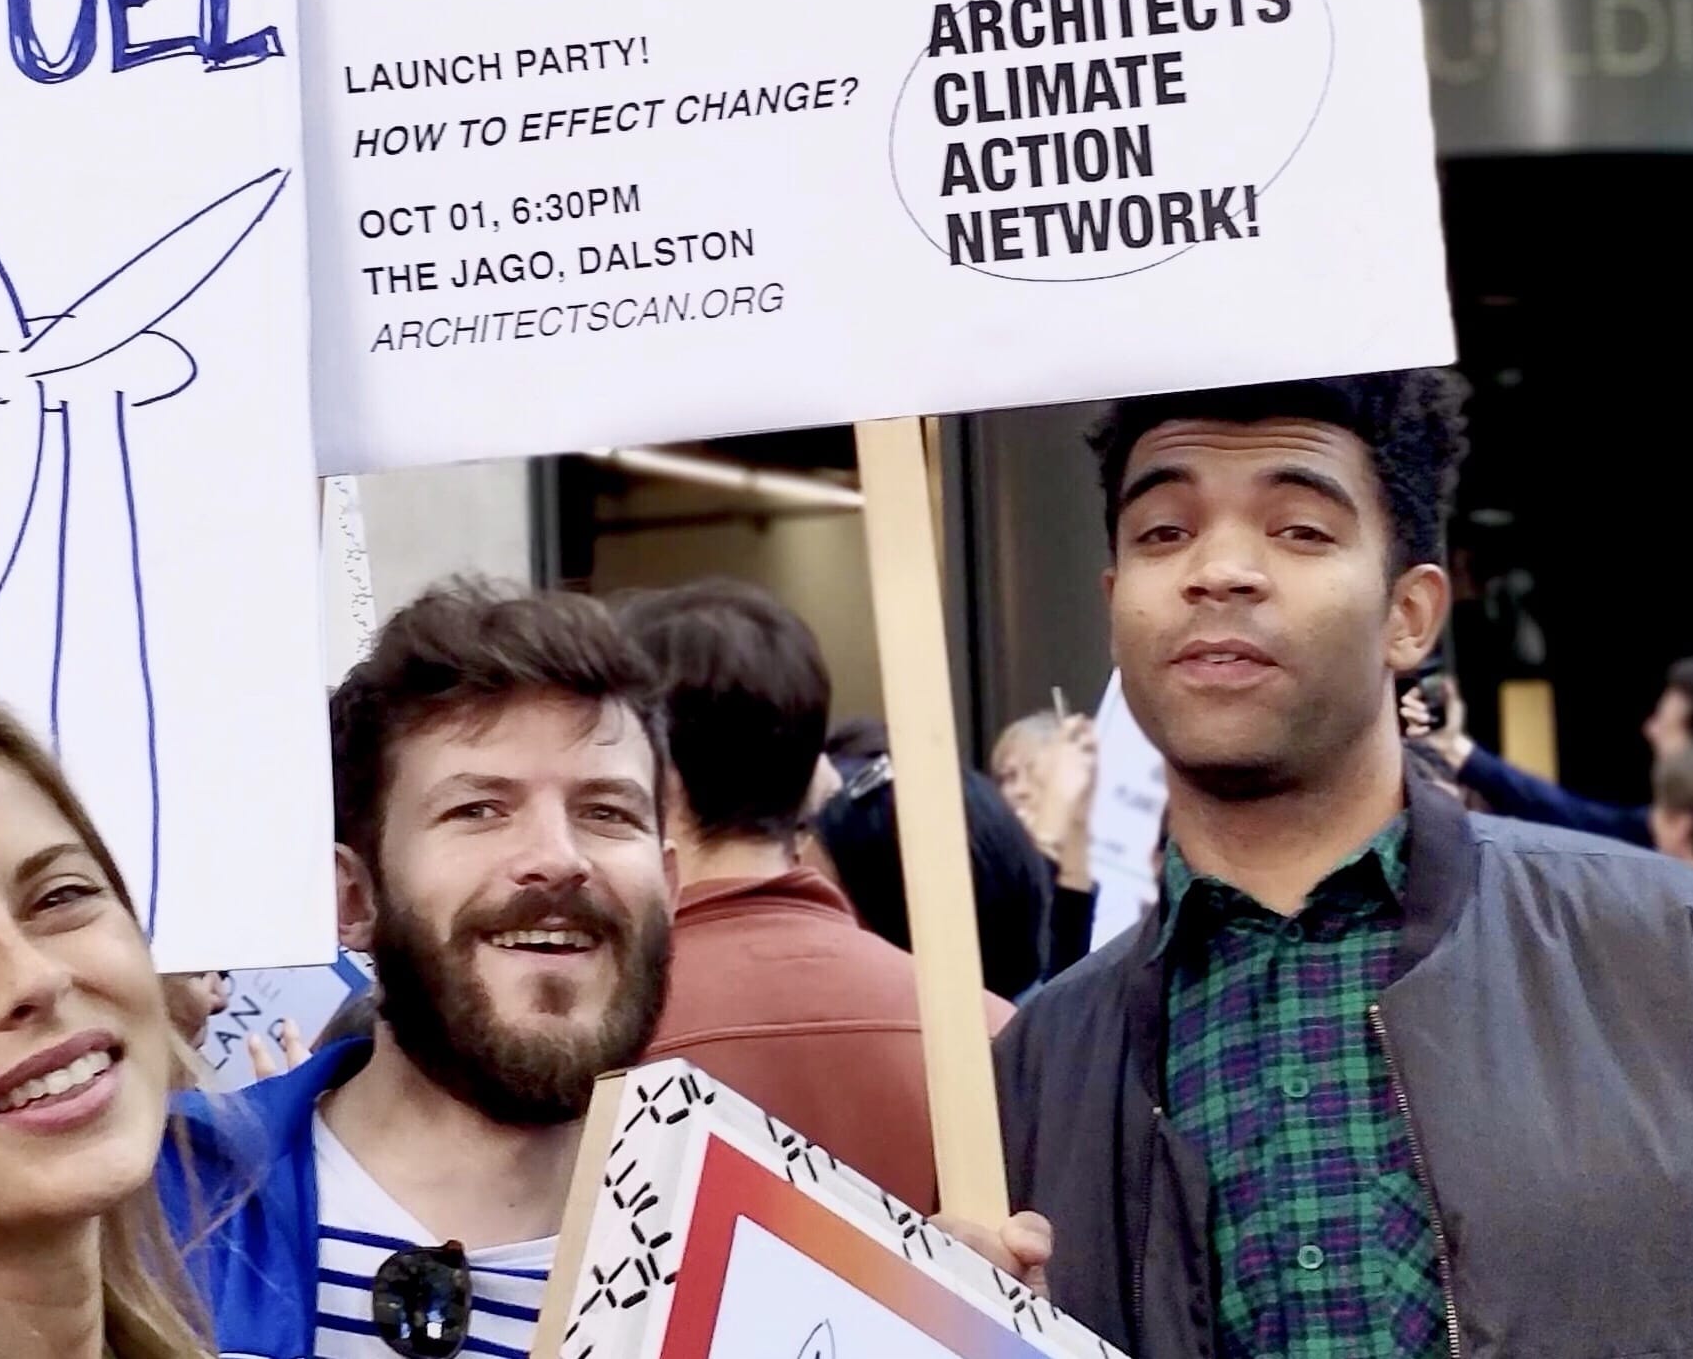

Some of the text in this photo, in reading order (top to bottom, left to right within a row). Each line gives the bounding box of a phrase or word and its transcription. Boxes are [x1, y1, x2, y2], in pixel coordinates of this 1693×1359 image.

[344, 35, 648, 94] LAUNCH PARTY!
[934, 51, 1187, 127] CLIMATE
[353, 76, 860, 159] HOW TO EFFECT CHANGE?
[940, 124, 1154, 197] ACTION
[359, 183, 642, 239] OCT 01, 6:30PM
[946, 183, 1263, 266] NETWORK!
[361, 228, 755, 296] THE JAGO, DALSTON
[370, 280, 786, 354] ARCHITECTSCAN.ORG
